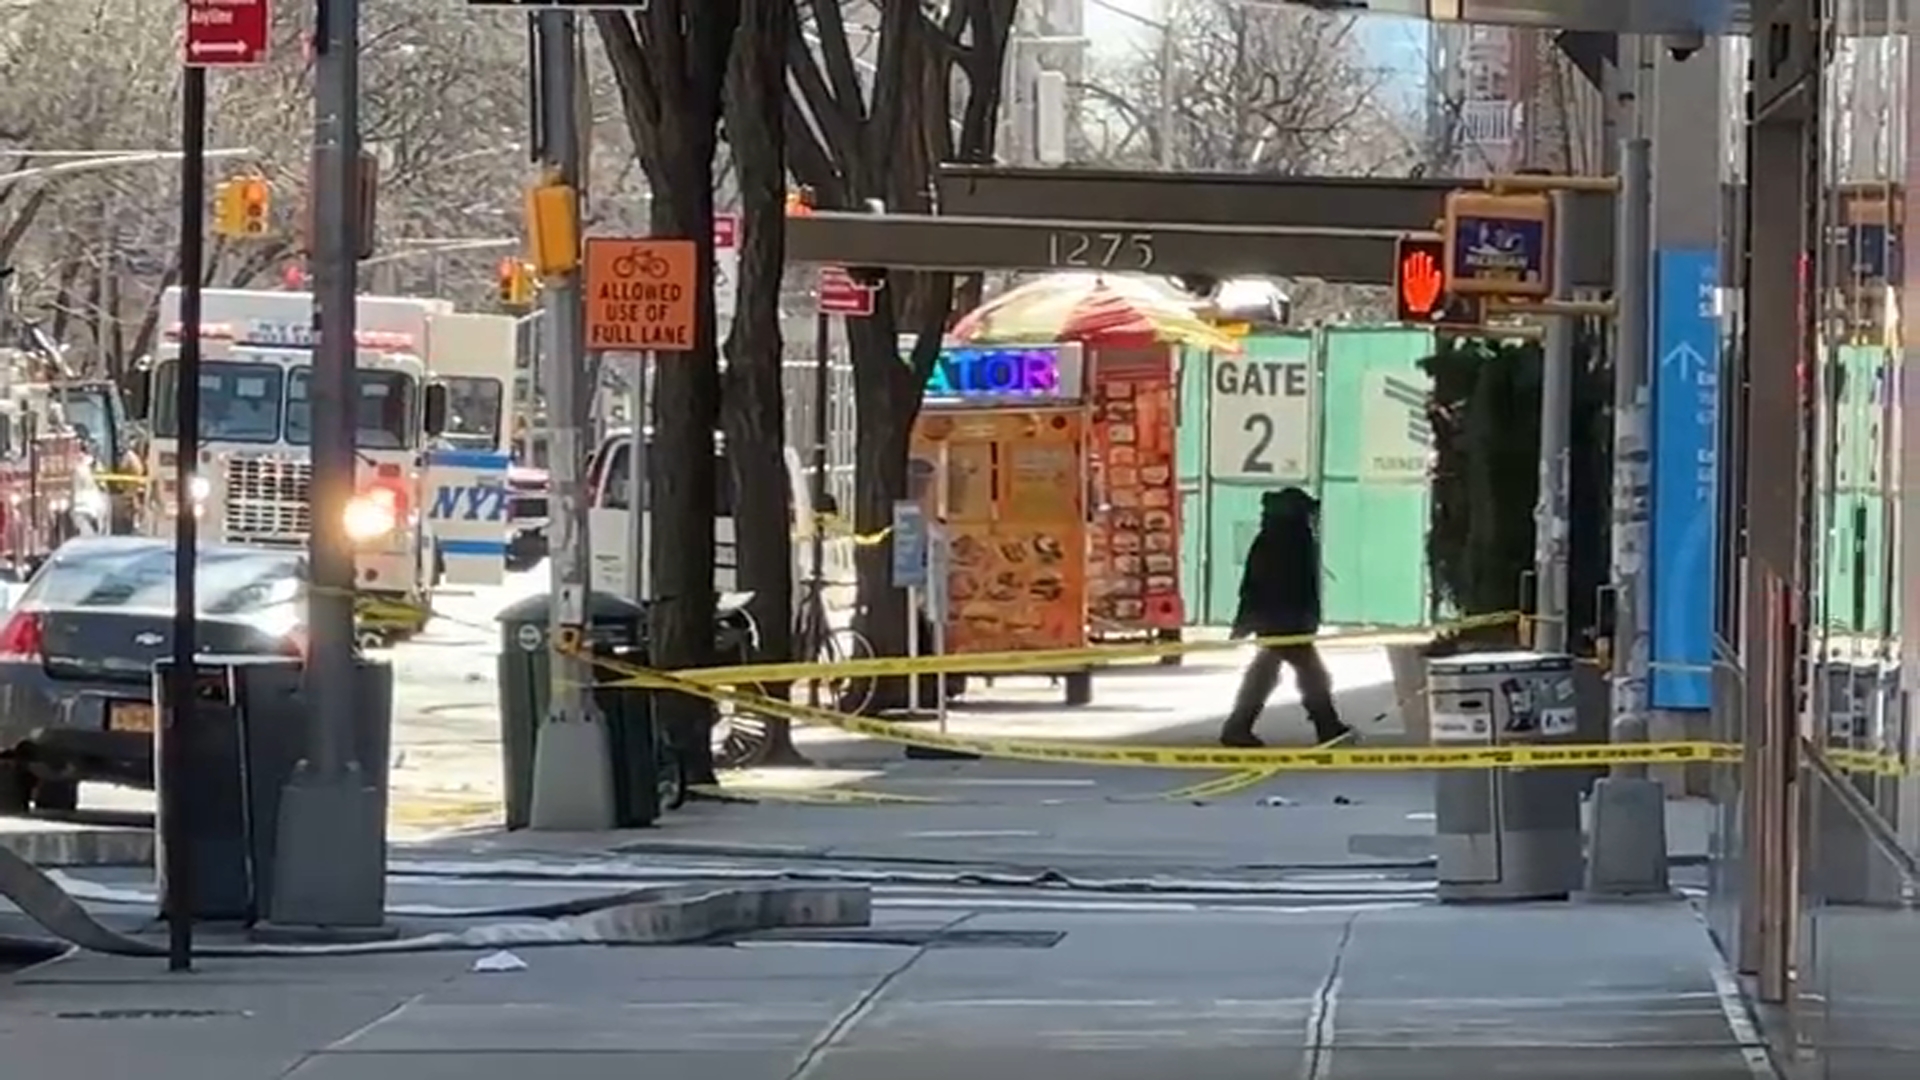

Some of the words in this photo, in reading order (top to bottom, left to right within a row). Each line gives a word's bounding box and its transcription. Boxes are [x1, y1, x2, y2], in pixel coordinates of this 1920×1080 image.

[1049, 233, 1153, 269] 1275
[599, 282, 682, 302] ALLOWED
[605, 304, 638, 322] USE
[645, 304, 668, 322] OF
[592, 325, 635, 343] FULL
[642, 325, 687, 345] LANE
[925, 353, 1057, 390] ATOR
[1215, 361, 1307, 396] GATE
[1241, 412, 1274, 473] 2
[427, 485, 507, 520] NYP
